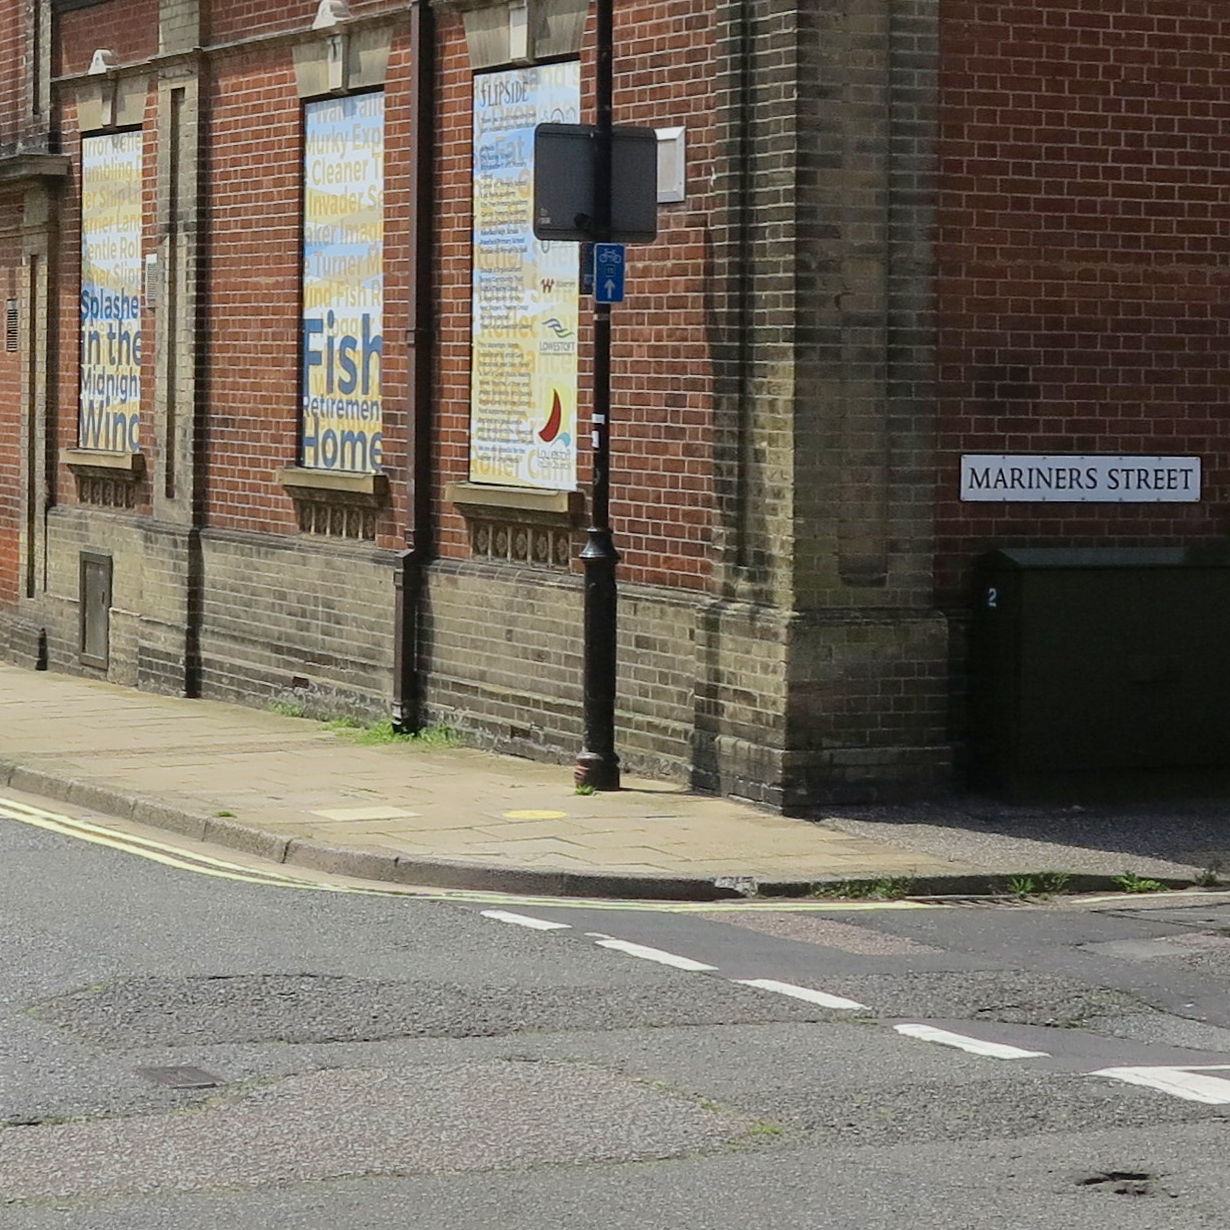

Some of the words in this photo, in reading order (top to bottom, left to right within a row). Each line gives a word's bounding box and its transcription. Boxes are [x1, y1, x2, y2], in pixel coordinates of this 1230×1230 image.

[312, 157, 368, 186] Cleaner
[308, 186, 365, 217] Invader
[315, 251, 364, 278] Turner
[81, 287, 139, 327] Splashe
[336, 278, 367, 307] Fish
[107, 317, 142, 367] the
[303, 310, 383, 396] Fish
[538, 341, 576, 351] LOWESTOFT
[303, 415, 383, 471] Home
[968, 467, 1098, 491] MARINERS
[1107, 468, 1194, 491] STREET
[988, 588, 997, 607] 2
